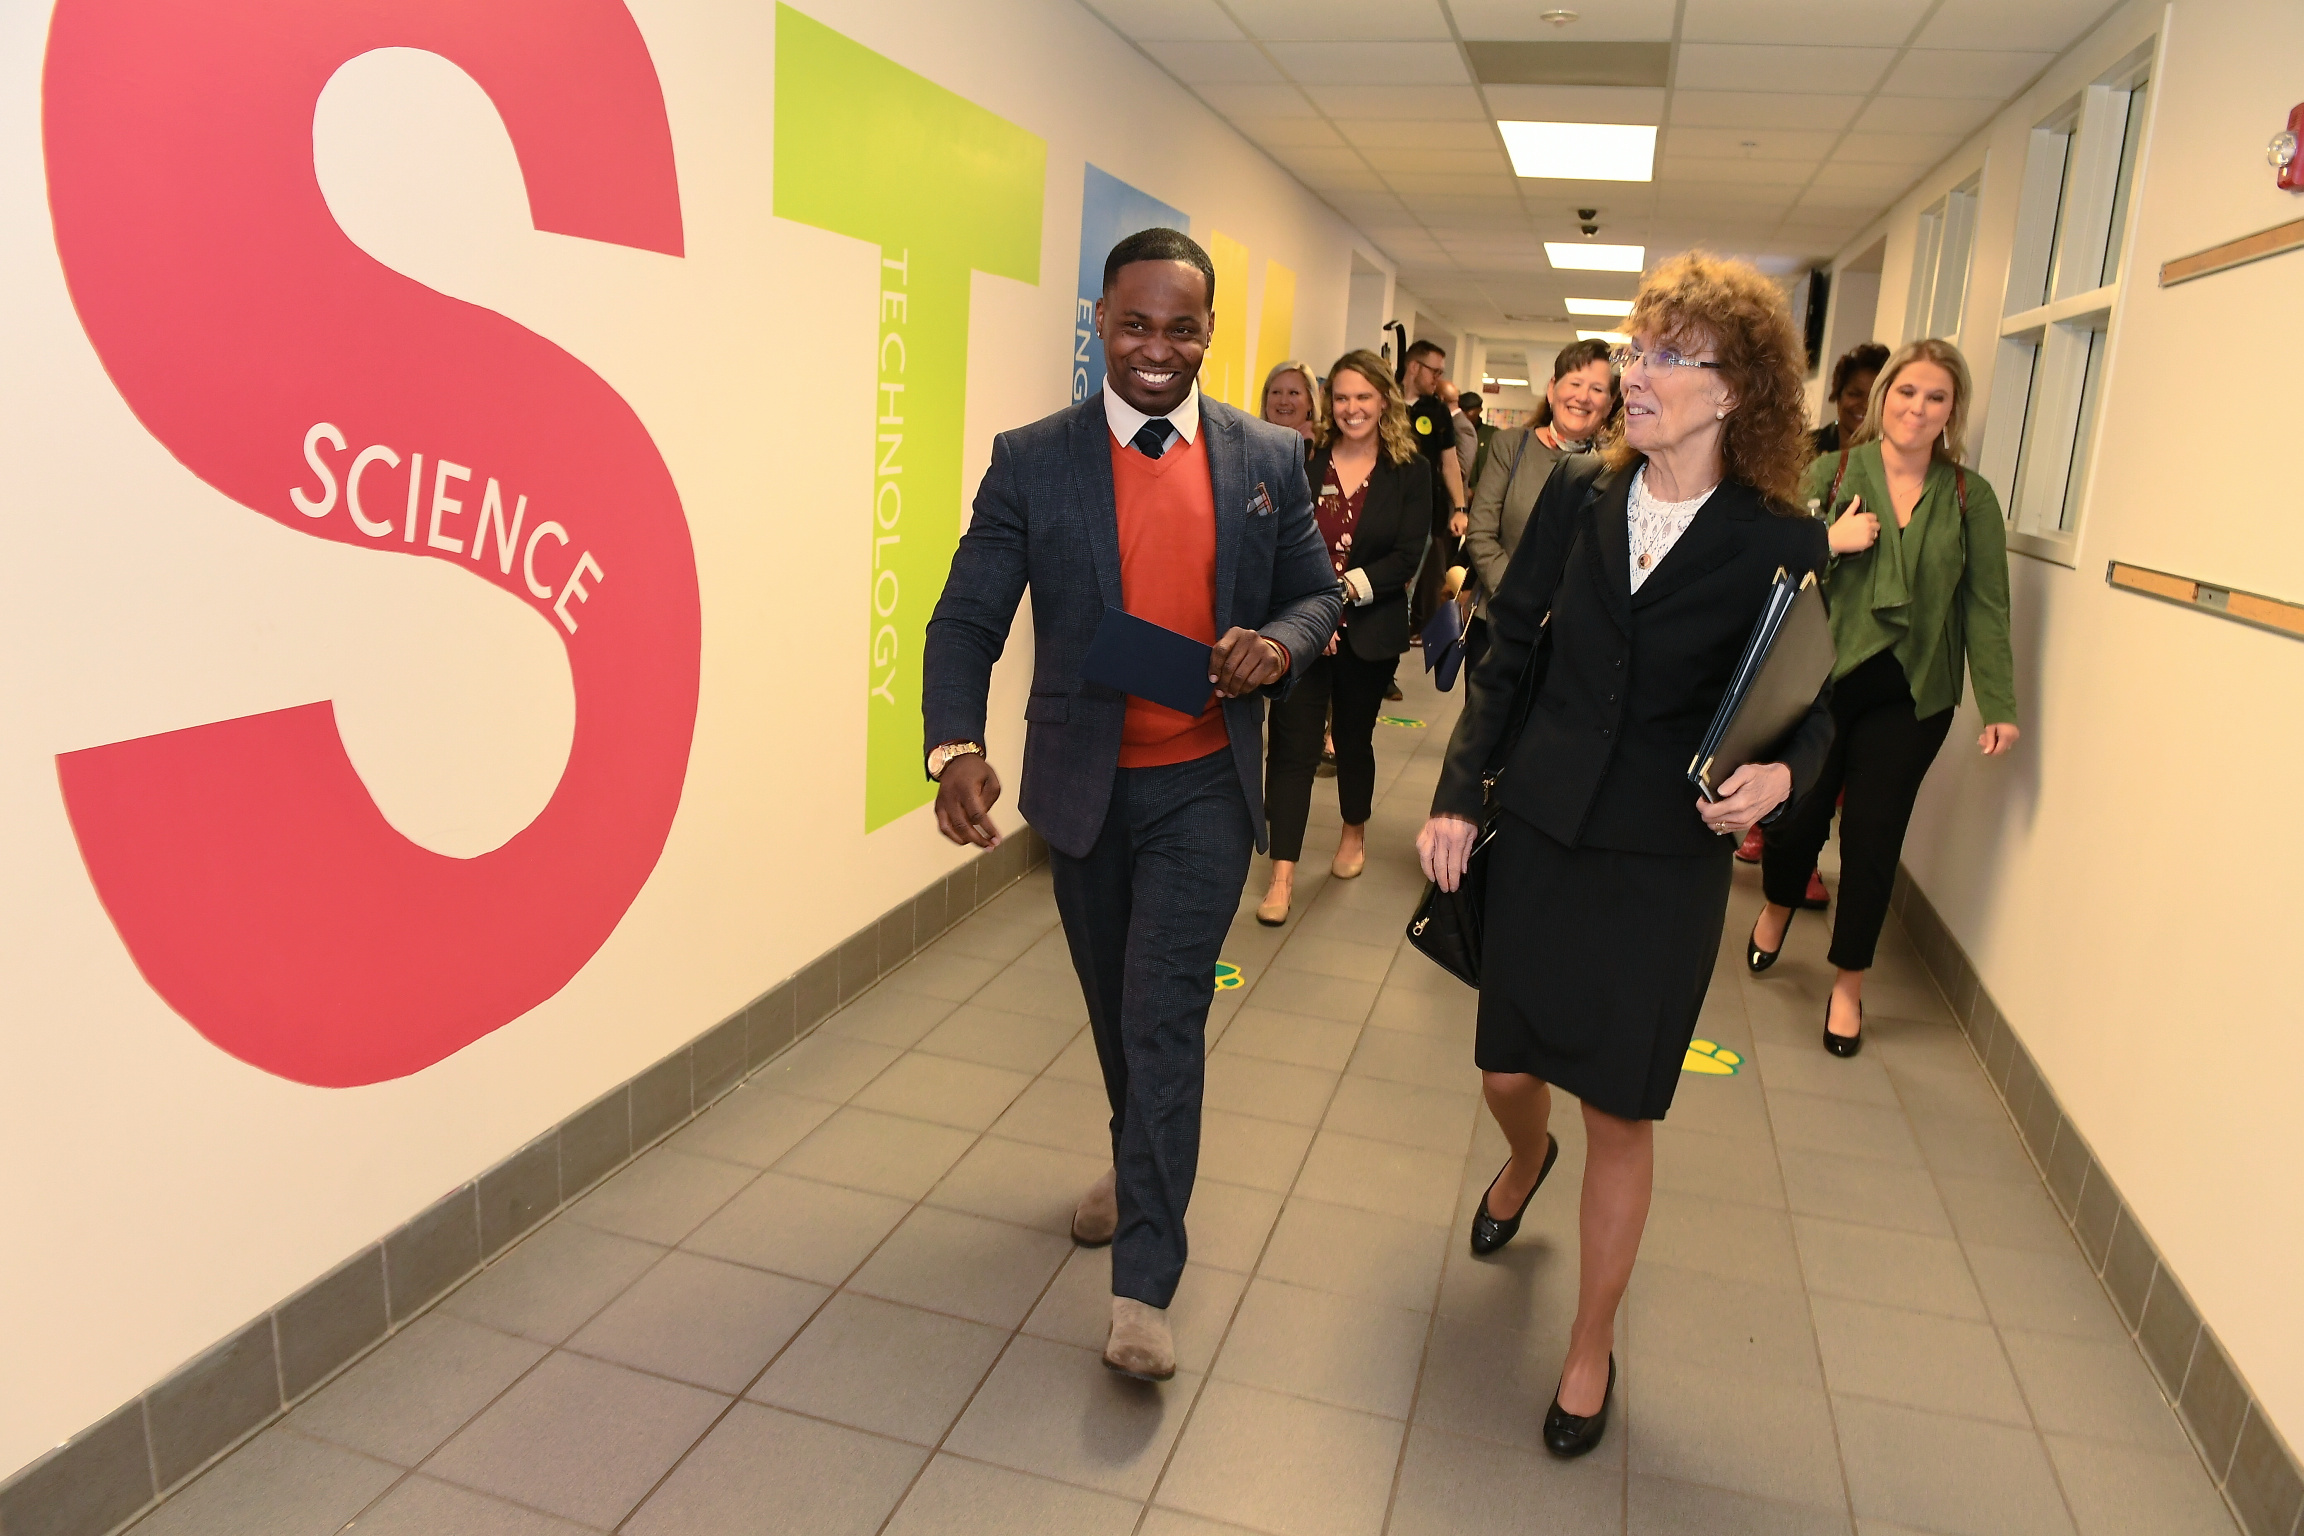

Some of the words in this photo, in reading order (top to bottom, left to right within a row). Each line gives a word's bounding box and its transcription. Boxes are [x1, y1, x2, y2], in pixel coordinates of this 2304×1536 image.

[42, 0, 702, 1089] S
[289, 422, 605, 635] SCIENCE
[774, 1, 1046, 834] T
[871, 248, 908, 706] TECHNOLOGY
